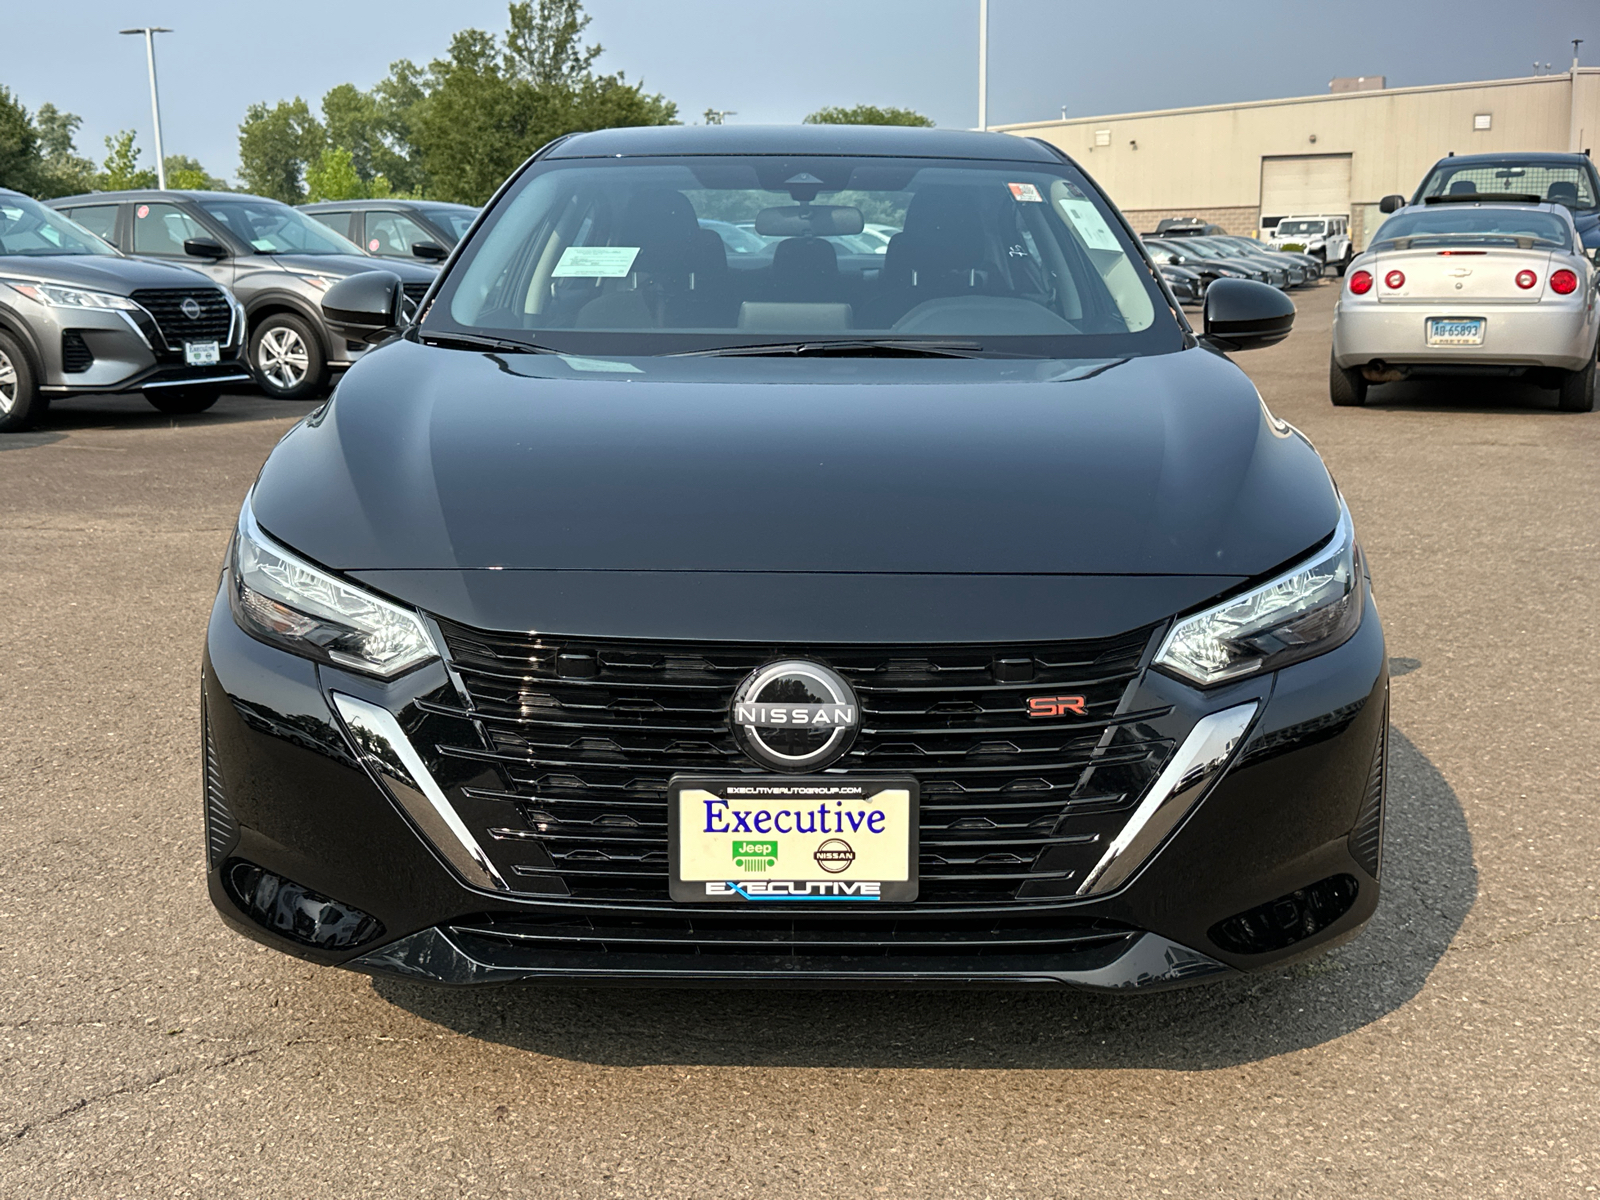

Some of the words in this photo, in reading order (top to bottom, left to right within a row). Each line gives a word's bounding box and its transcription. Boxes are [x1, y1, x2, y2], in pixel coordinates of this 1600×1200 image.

[1029, 696, 1087, 716] SR
[738, 705, 852, 725] NISSAN
[703, 800, 886, 834] Executive
[738, 842, 772, 856] Jeep
[816, 851, 854, 860] NISSAN
[705, 881, 882, 896] EXECUTIVE
